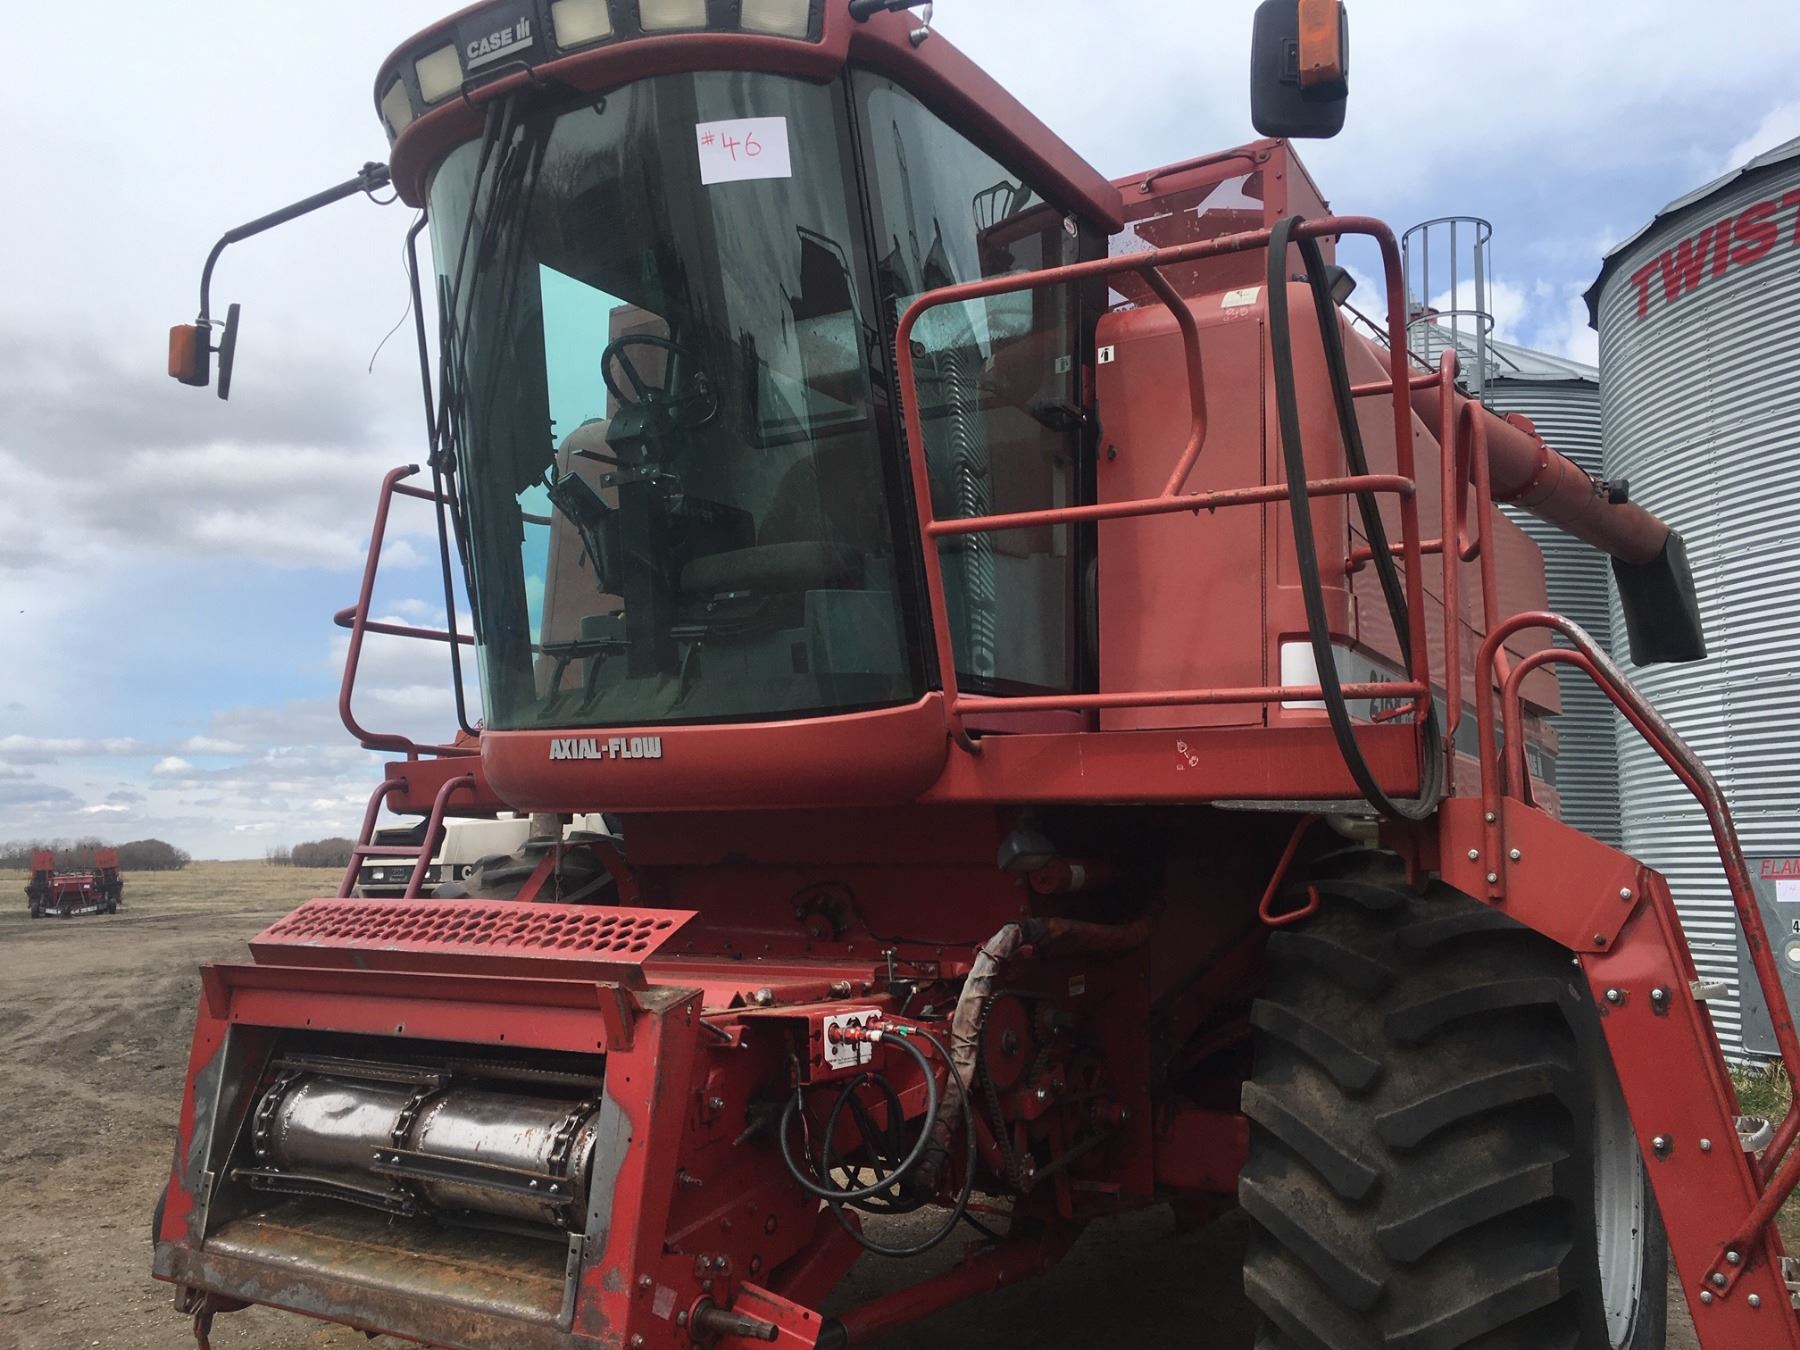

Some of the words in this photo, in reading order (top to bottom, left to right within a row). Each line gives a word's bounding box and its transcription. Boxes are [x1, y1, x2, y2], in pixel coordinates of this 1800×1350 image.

[467, 27, 513, 58] CASE
[701, 130, 762, 162] #46
[549, 736, 662, 760] AXIAL-FLOW
